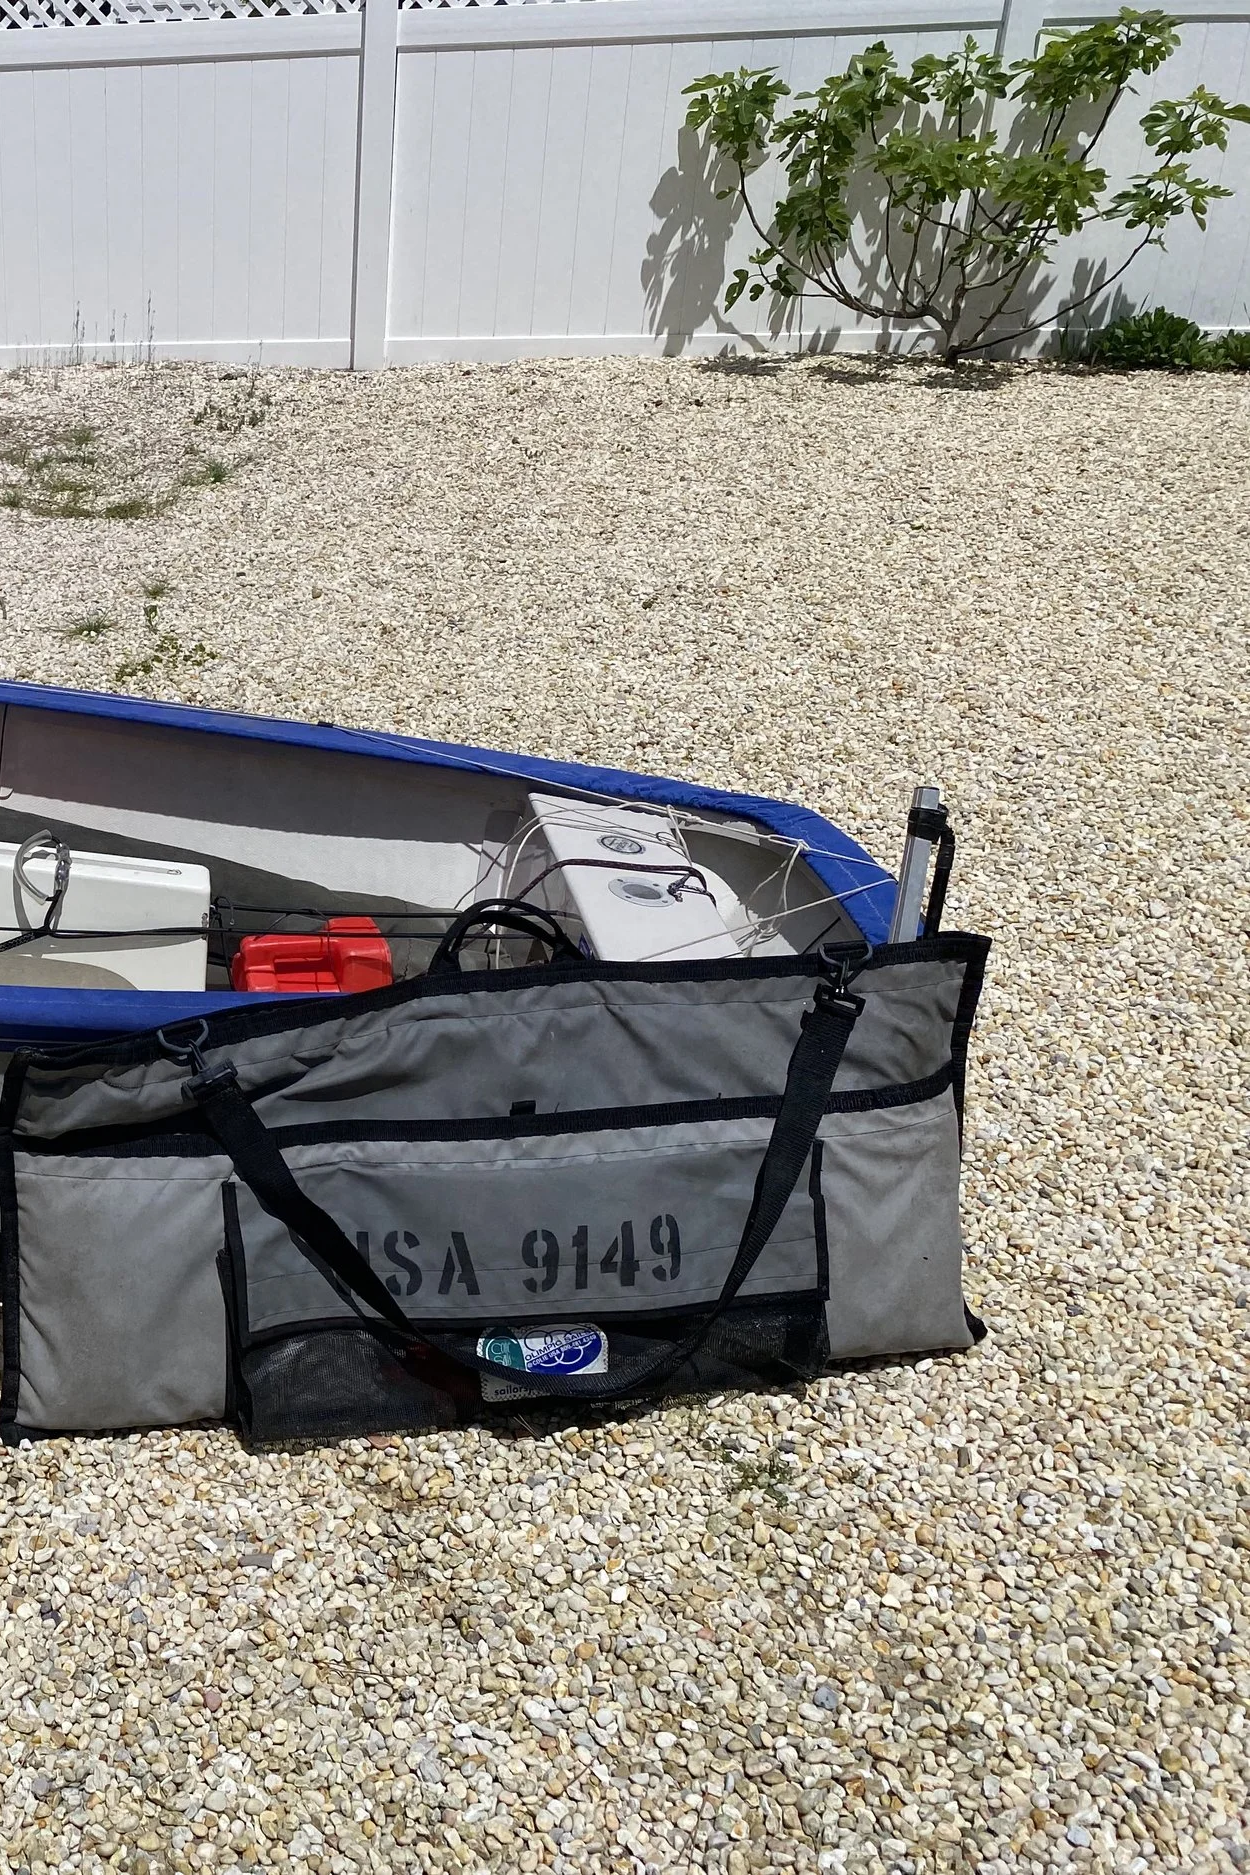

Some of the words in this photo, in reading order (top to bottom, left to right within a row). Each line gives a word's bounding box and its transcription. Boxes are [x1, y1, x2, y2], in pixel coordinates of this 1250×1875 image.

[521, 1213, 682, 1293] 9149
[525, 1339, 562, 1361] OLIMPIC
[532, 1354, 549, 1366] COLIE
[549, 1348, 561, 1358] USA
